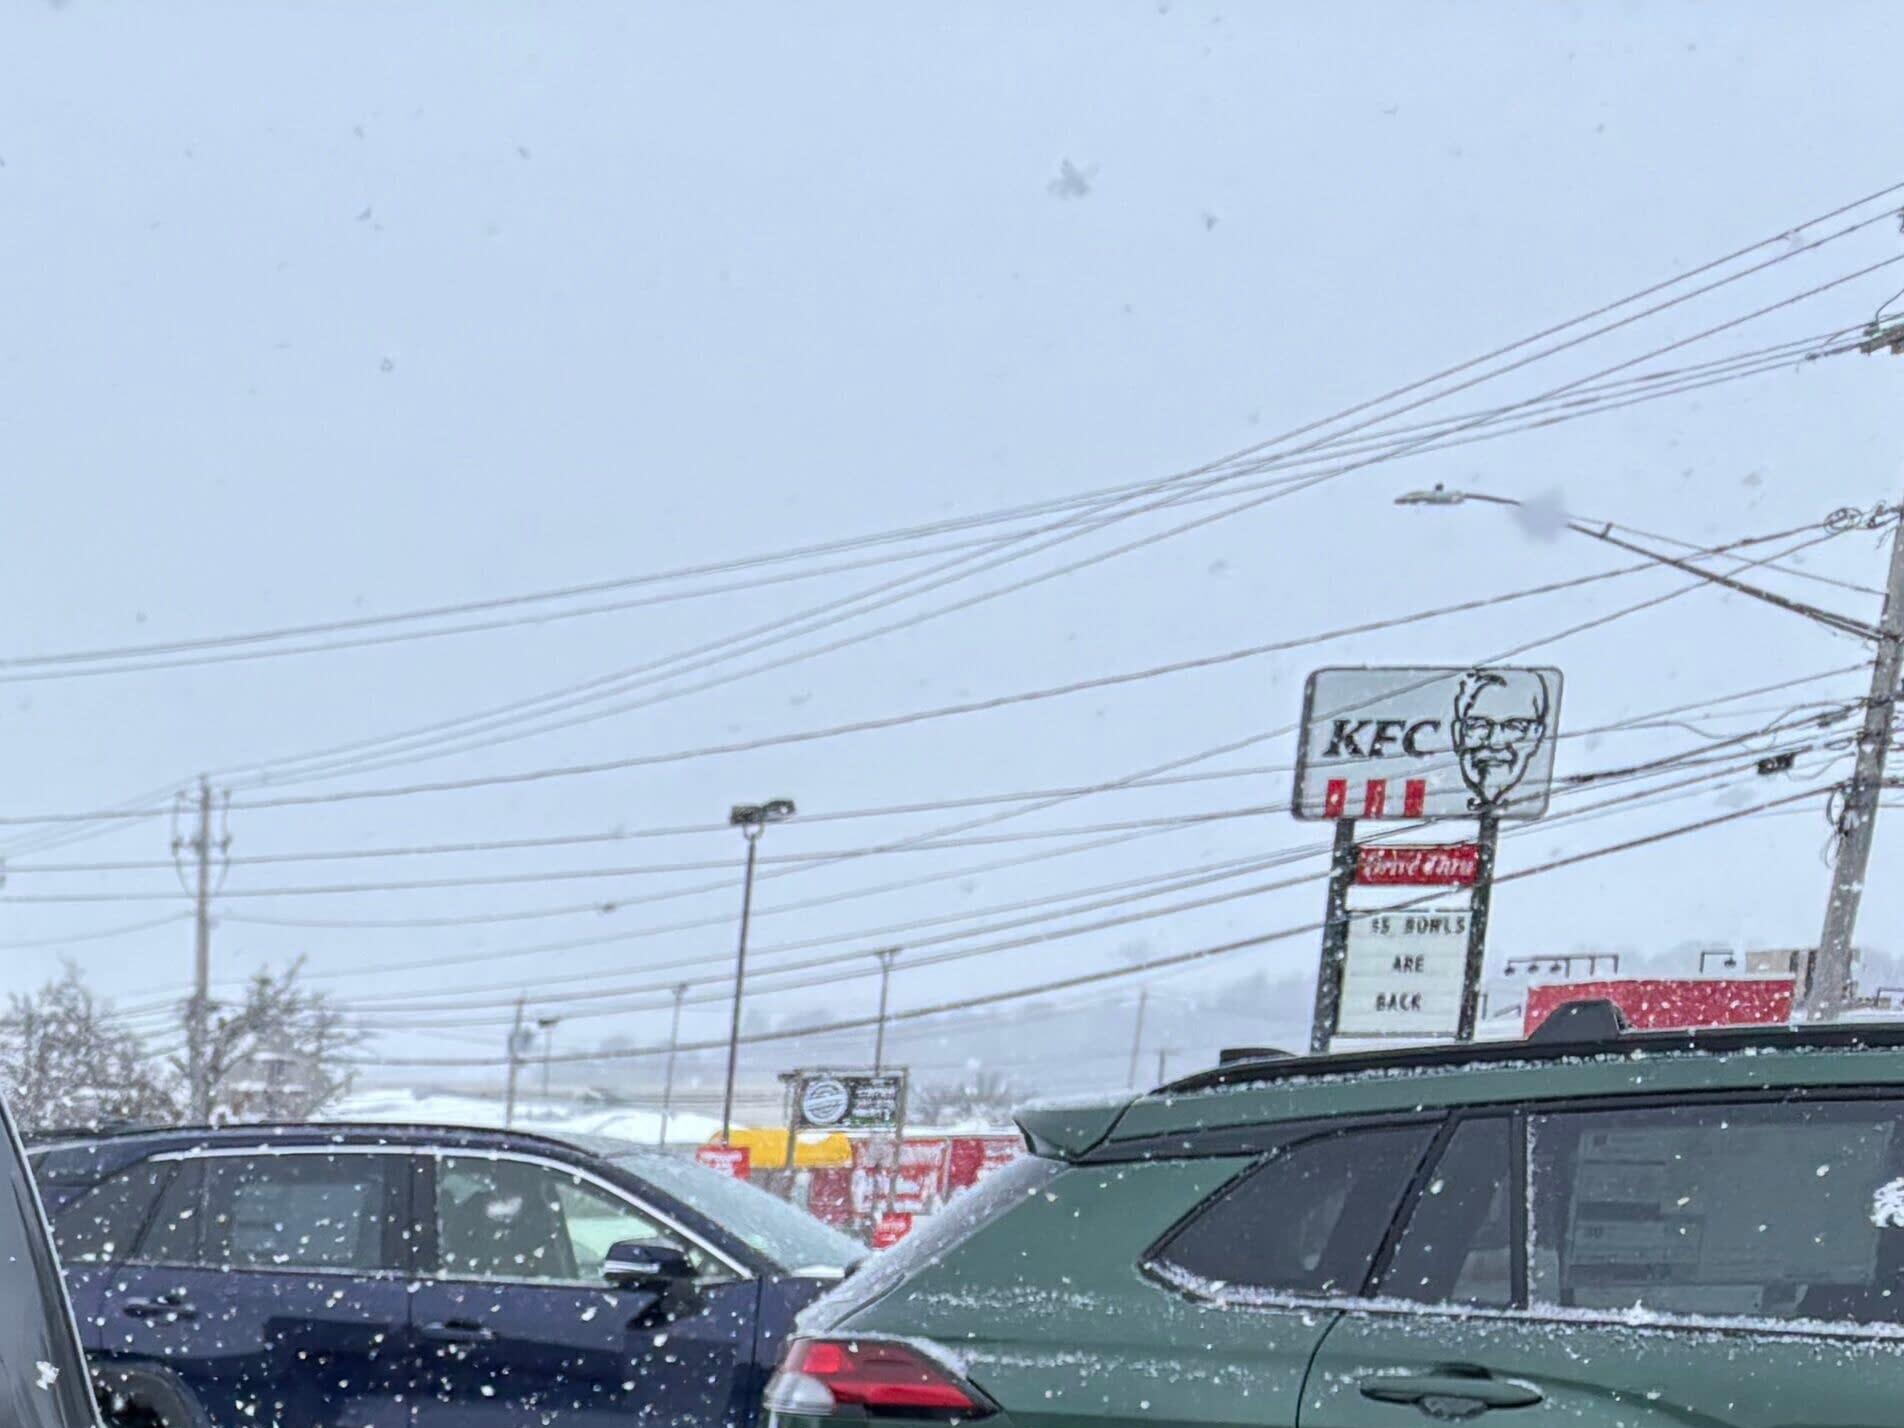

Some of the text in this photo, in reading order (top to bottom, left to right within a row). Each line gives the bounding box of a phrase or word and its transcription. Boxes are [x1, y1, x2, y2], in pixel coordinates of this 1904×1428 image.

[1323, 719, 1441, 757] KFC
[1404, 916, 1466, 935] BOWLS
[1393, 954, 1425, 974] ARE
[1376, 992, 1422, 1012] BACK
